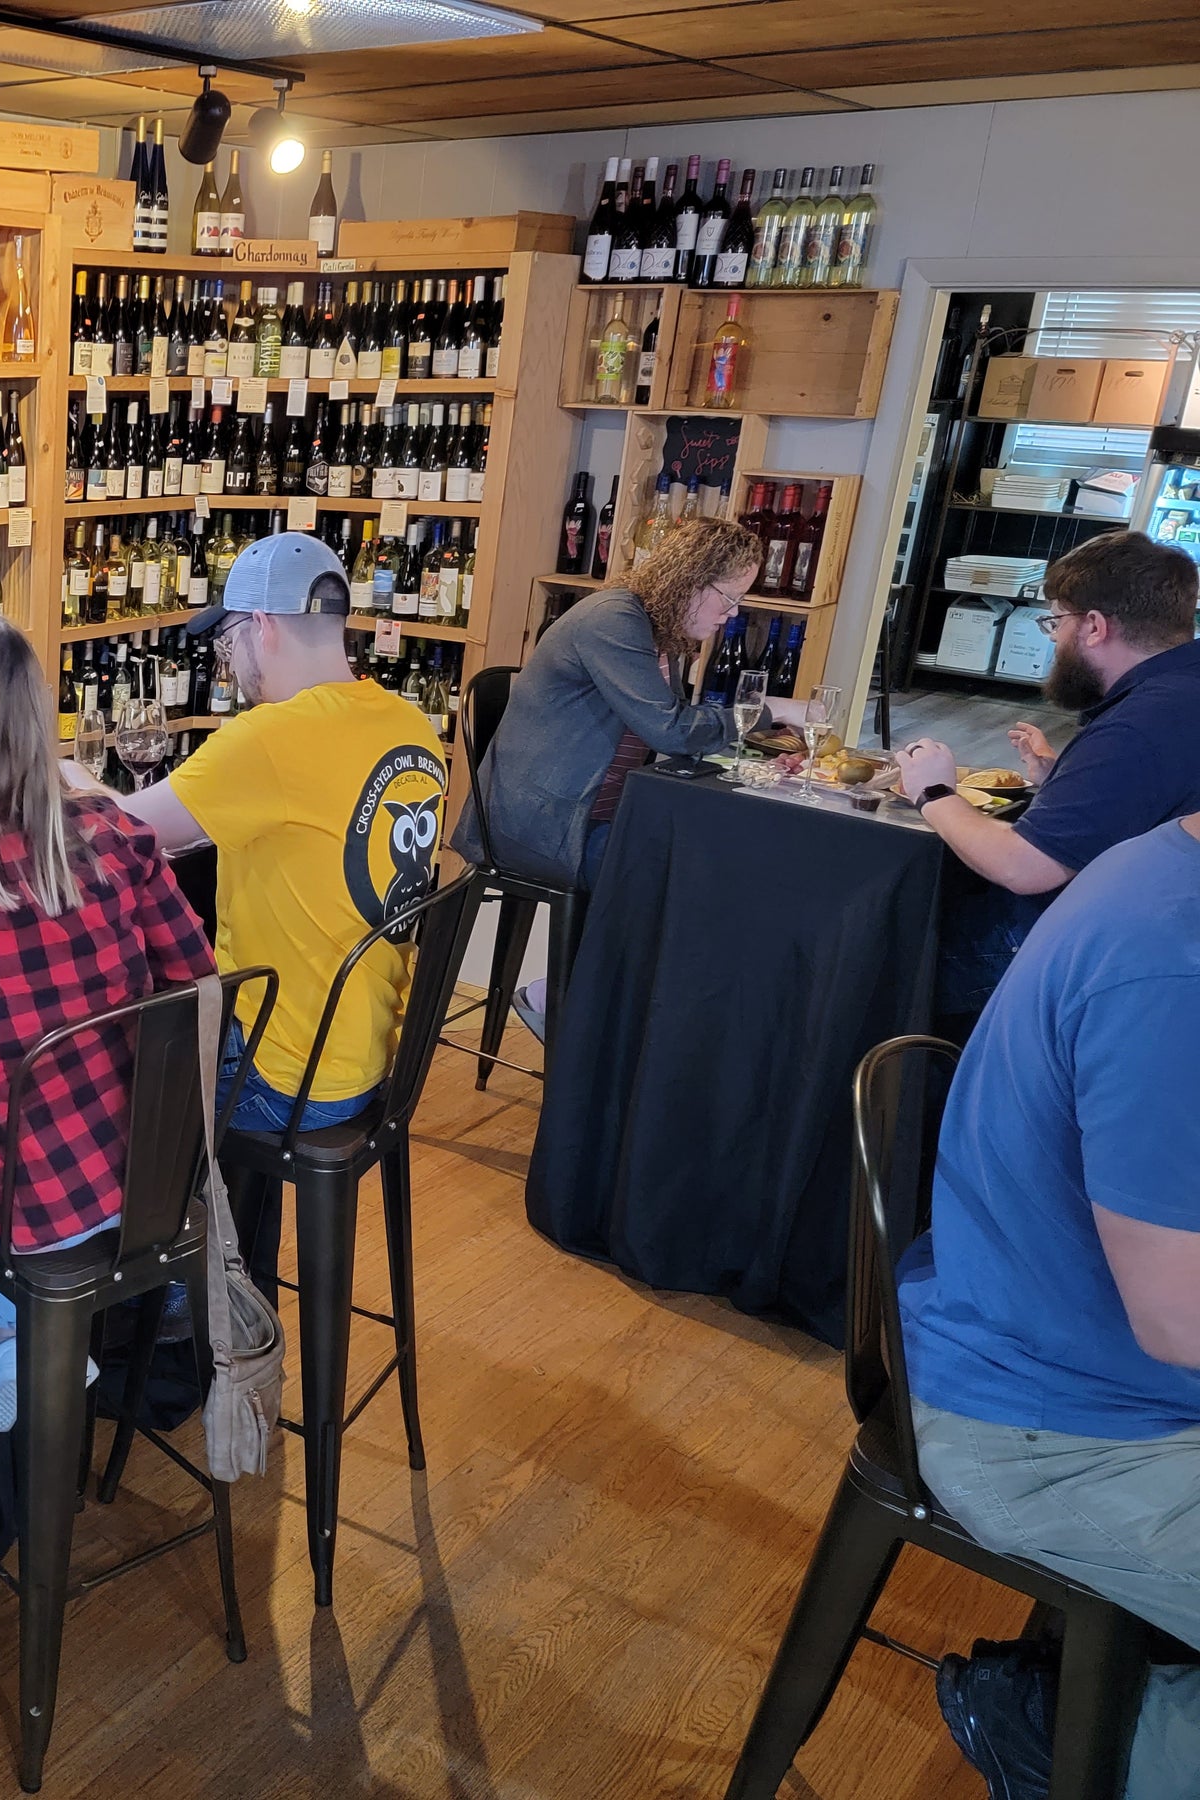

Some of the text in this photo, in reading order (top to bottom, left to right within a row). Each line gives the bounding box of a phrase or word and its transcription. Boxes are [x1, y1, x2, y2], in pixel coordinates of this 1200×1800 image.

[235, 241, 308, 266] Chardonnay
[681, 425, 720, 459] Sweet
[695, 449, 730, 475] Sips
[356, 765, 393, 834] CROSS-EYED
[394, 755, 415, 771] OWL
